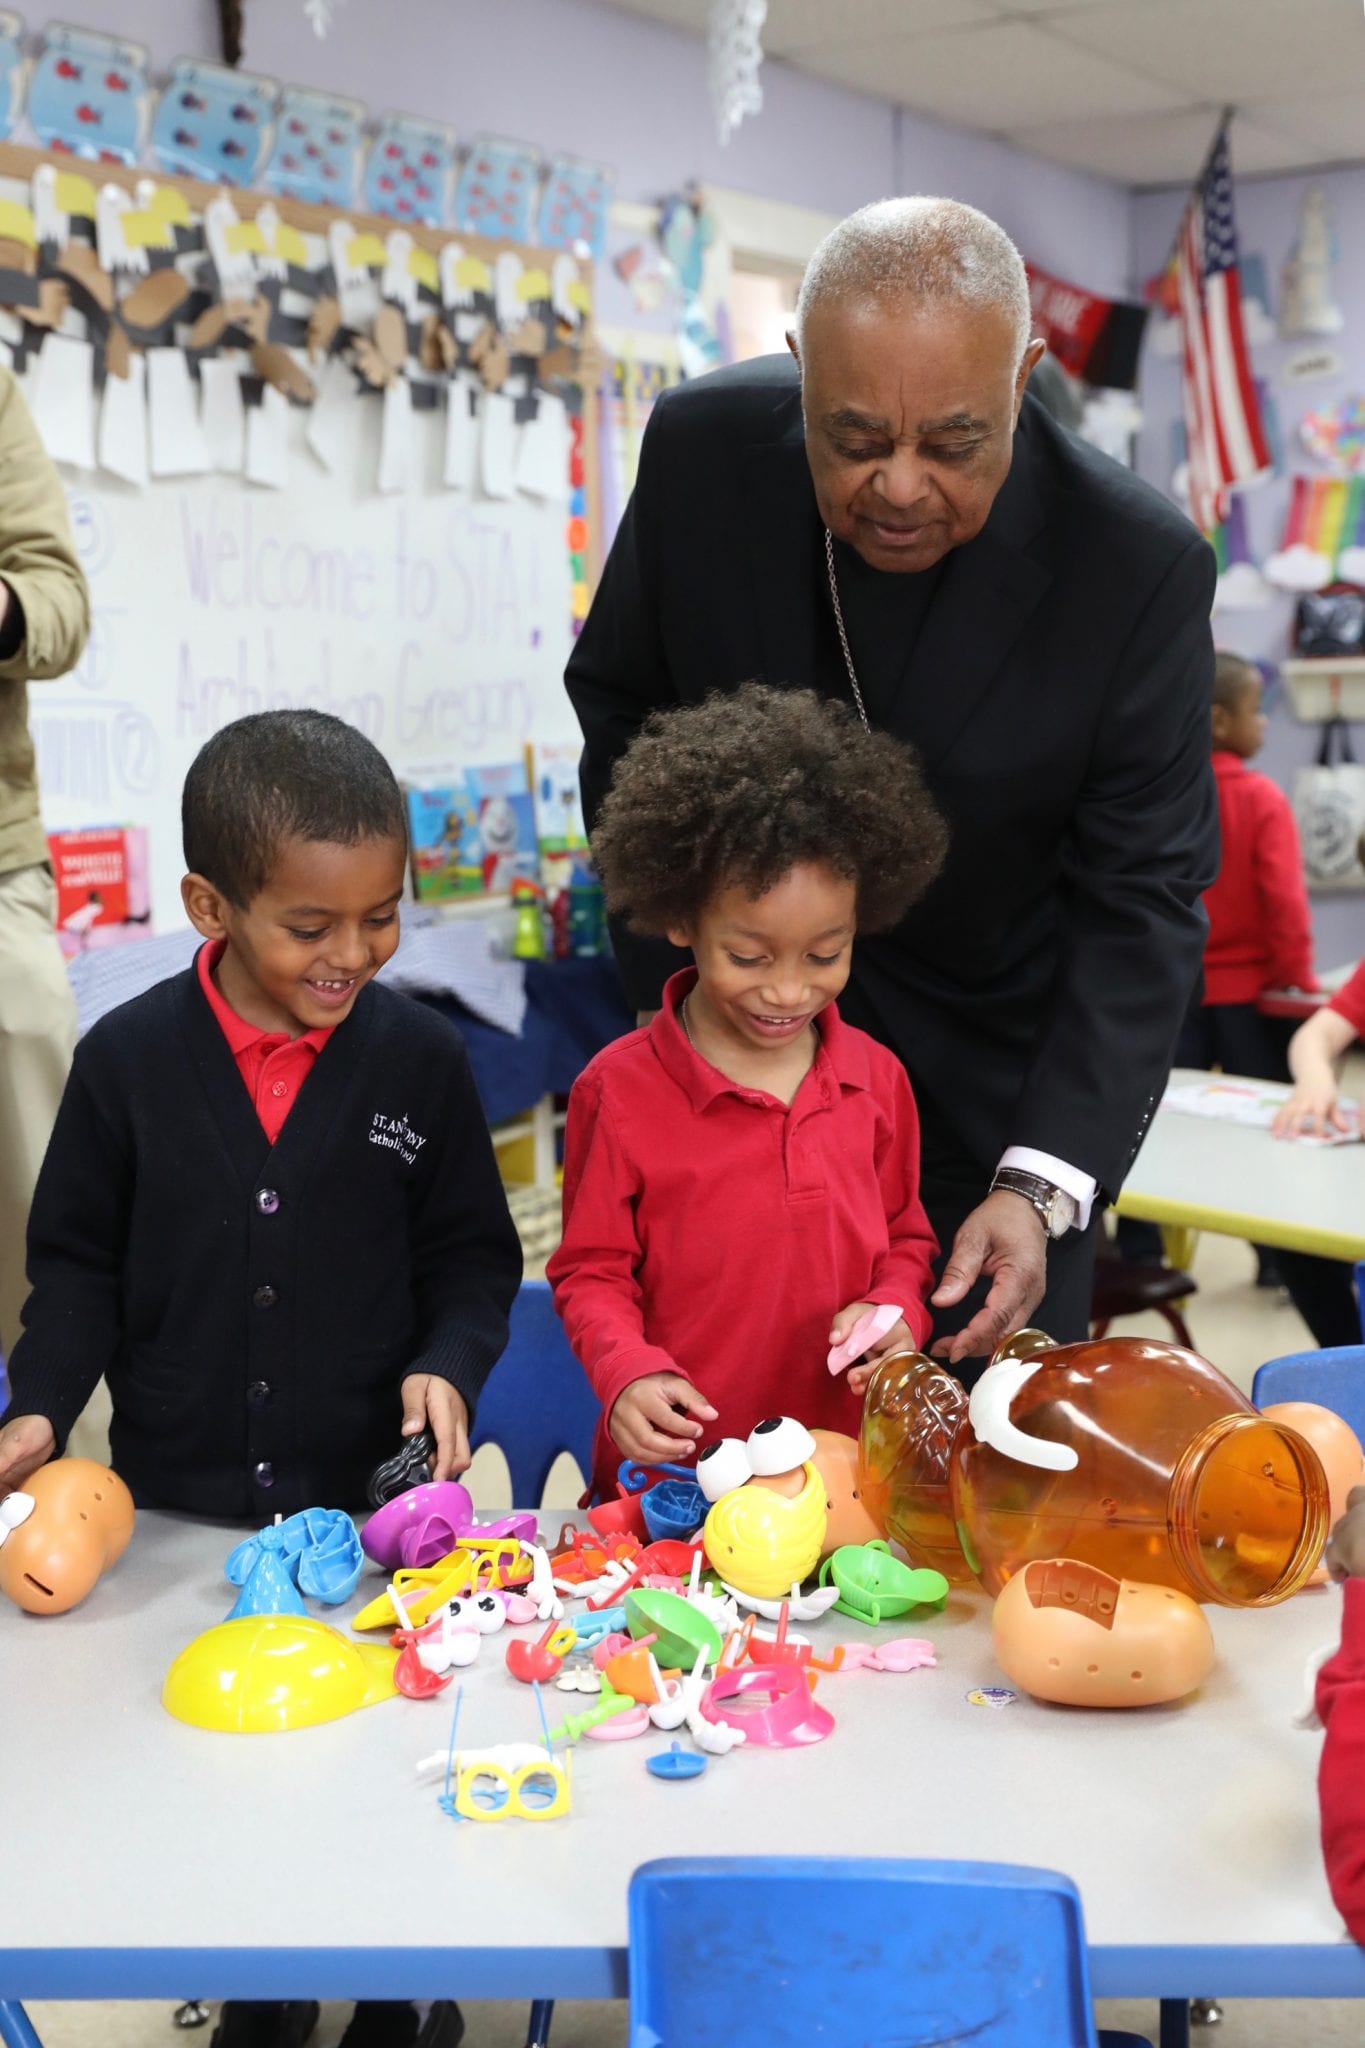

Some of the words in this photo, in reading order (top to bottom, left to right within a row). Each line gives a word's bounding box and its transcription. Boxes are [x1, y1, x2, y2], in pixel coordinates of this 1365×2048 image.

[176, 492, 375, 621] Welcome
[393, 503, 438, 622] to
[396, 639, 533, 750] Gregory
[368, 1129, 403, 1151] Catholi
